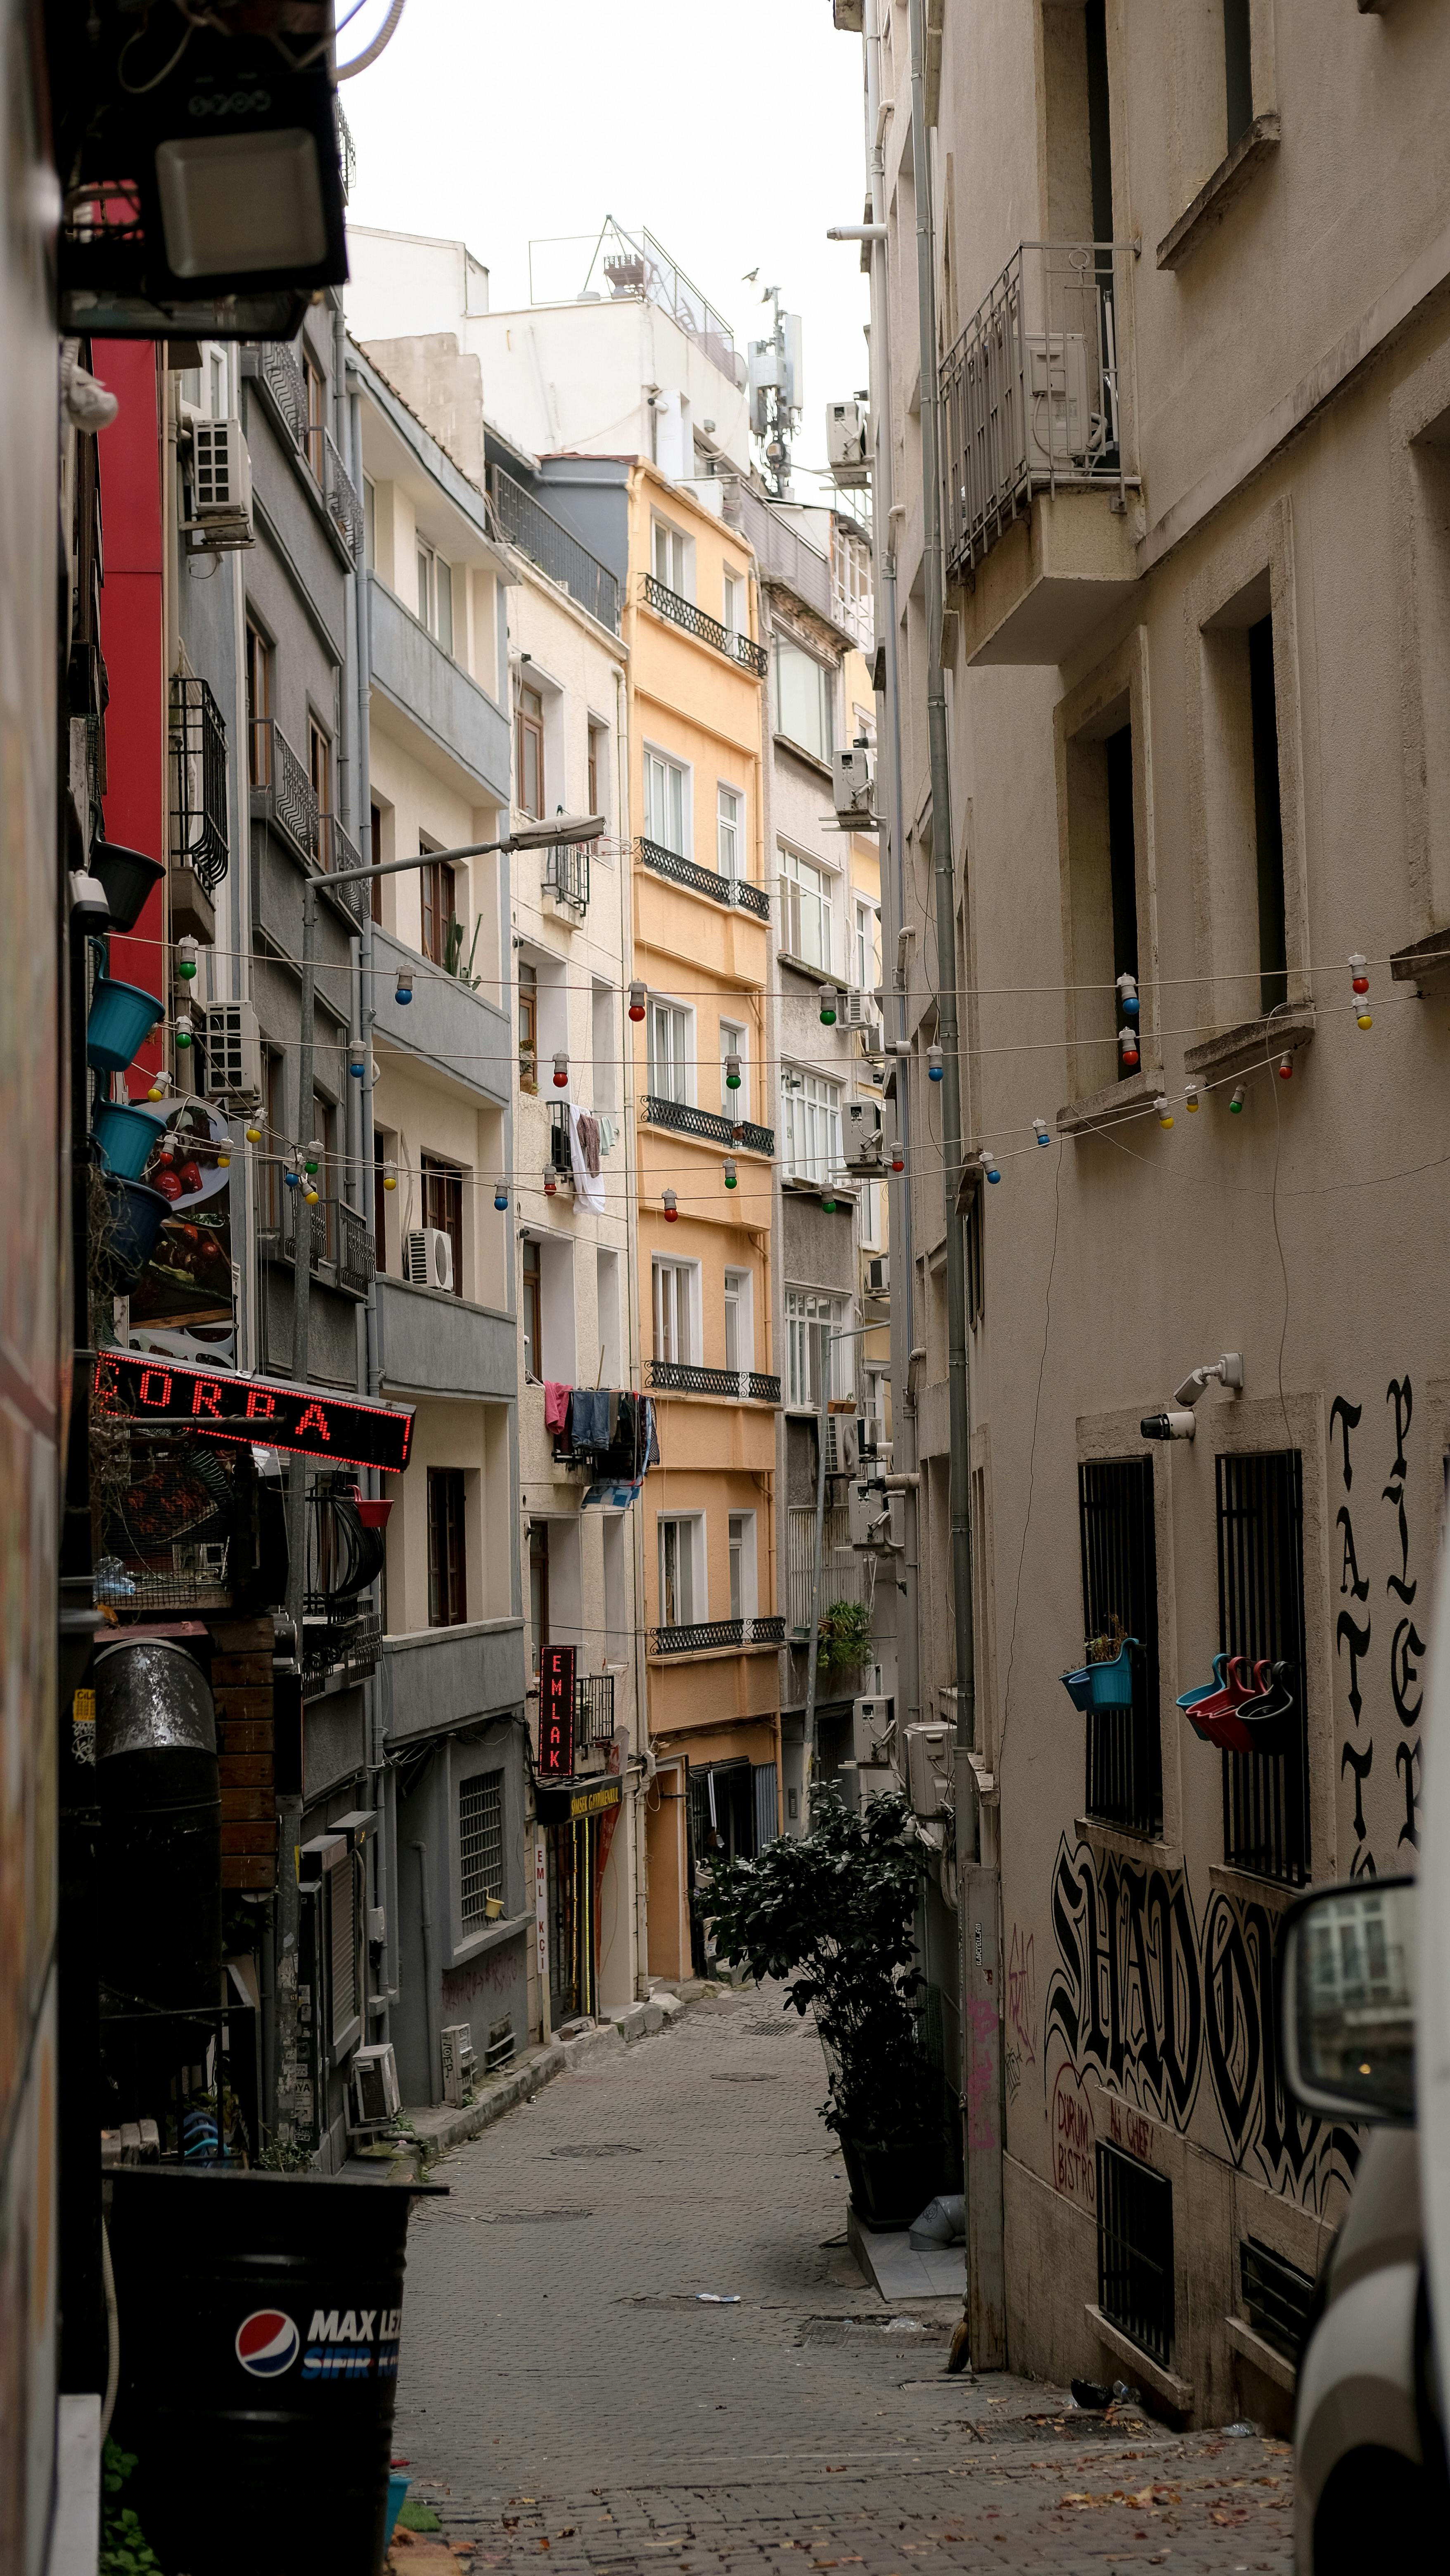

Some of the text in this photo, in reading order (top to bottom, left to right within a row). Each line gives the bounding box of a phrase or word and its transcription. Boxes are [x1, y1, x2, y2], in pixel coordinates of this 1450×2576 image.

[550, 1655, 562, 1767] EMLAK
[1058, 2089, 1089, 2152] DÜRÜM
[1058, 2142, 1095, 2203] BISTRO
[307, 2310, 377, 2342] MAX
[301, 2347, 374, 2379] SIFIR
